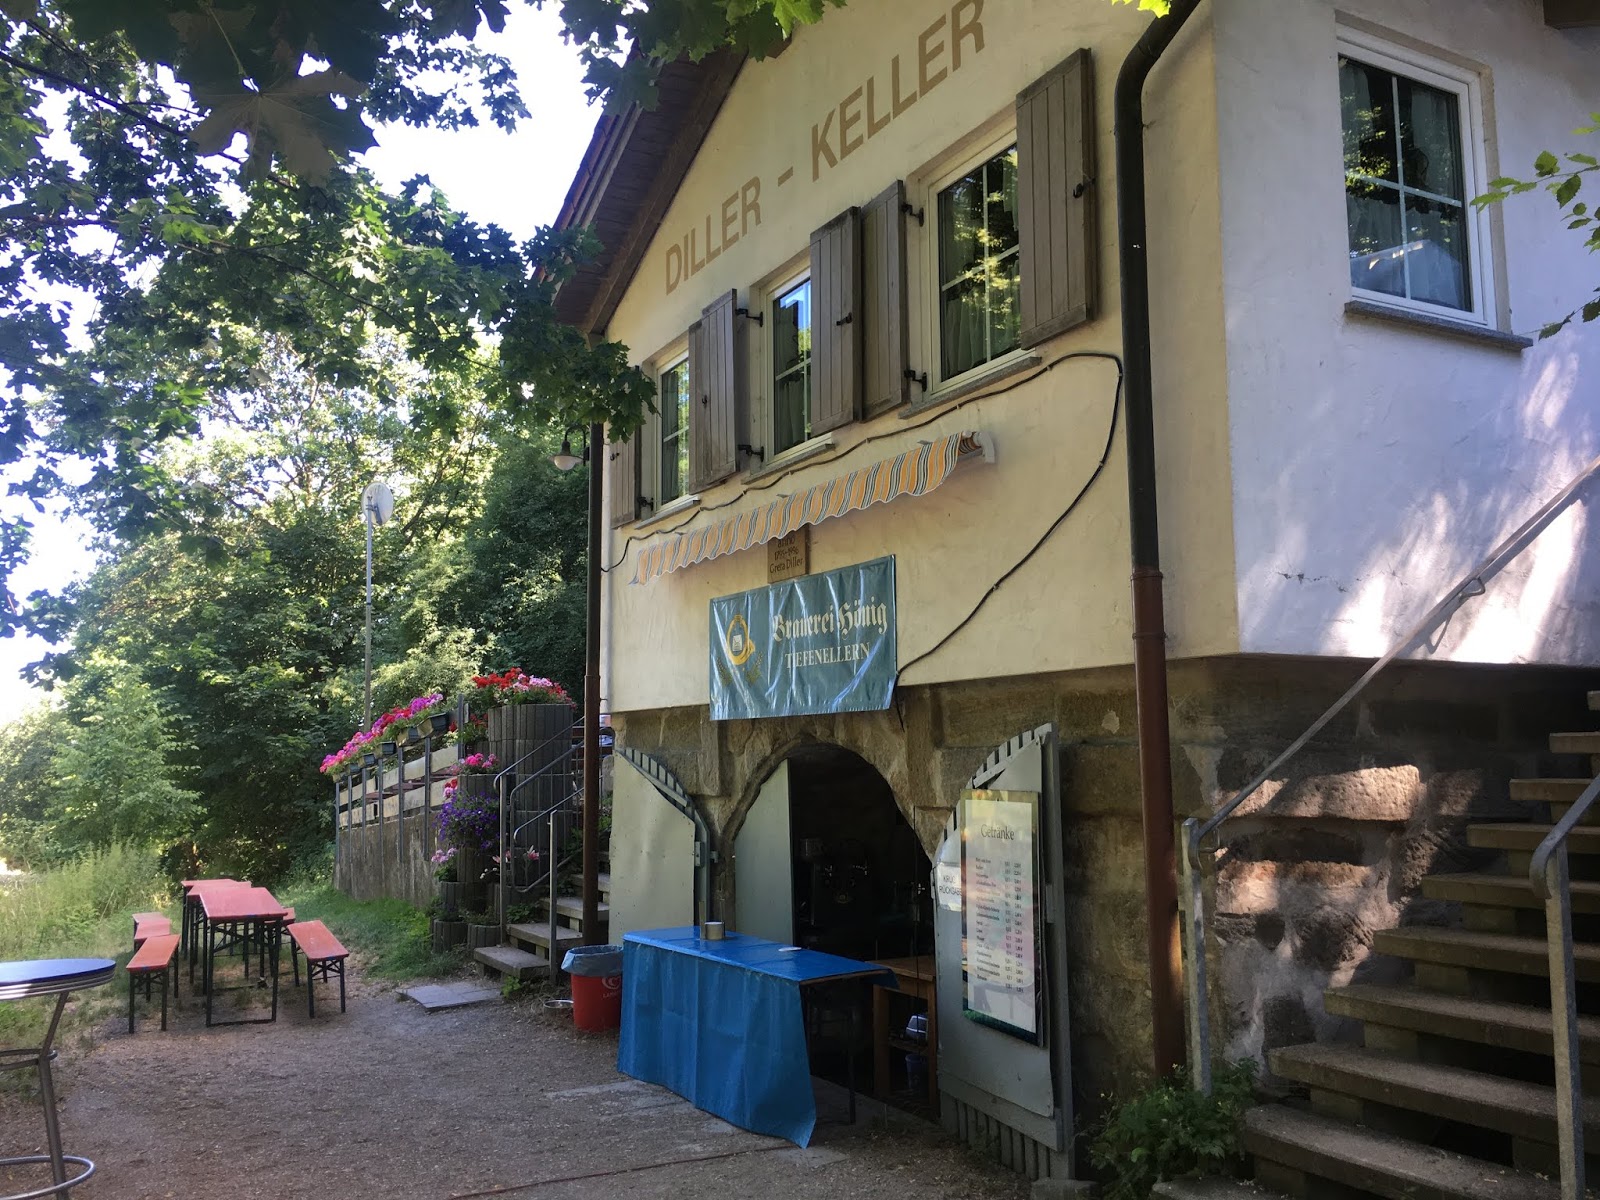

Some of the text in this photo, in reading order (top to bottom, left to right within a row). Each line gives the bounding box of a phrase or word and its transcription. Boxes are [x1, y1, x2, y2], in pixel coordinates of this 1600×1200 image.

[665, 0, 985, 296] DILLER - KELLER
[786, 556, 804, 570] Diller
[773, 596, 887, 642] Brauerei Hönig
[785, 642, 870, 668] TIEFENELLERN
[980, 823, 1015, 841] Getränke
